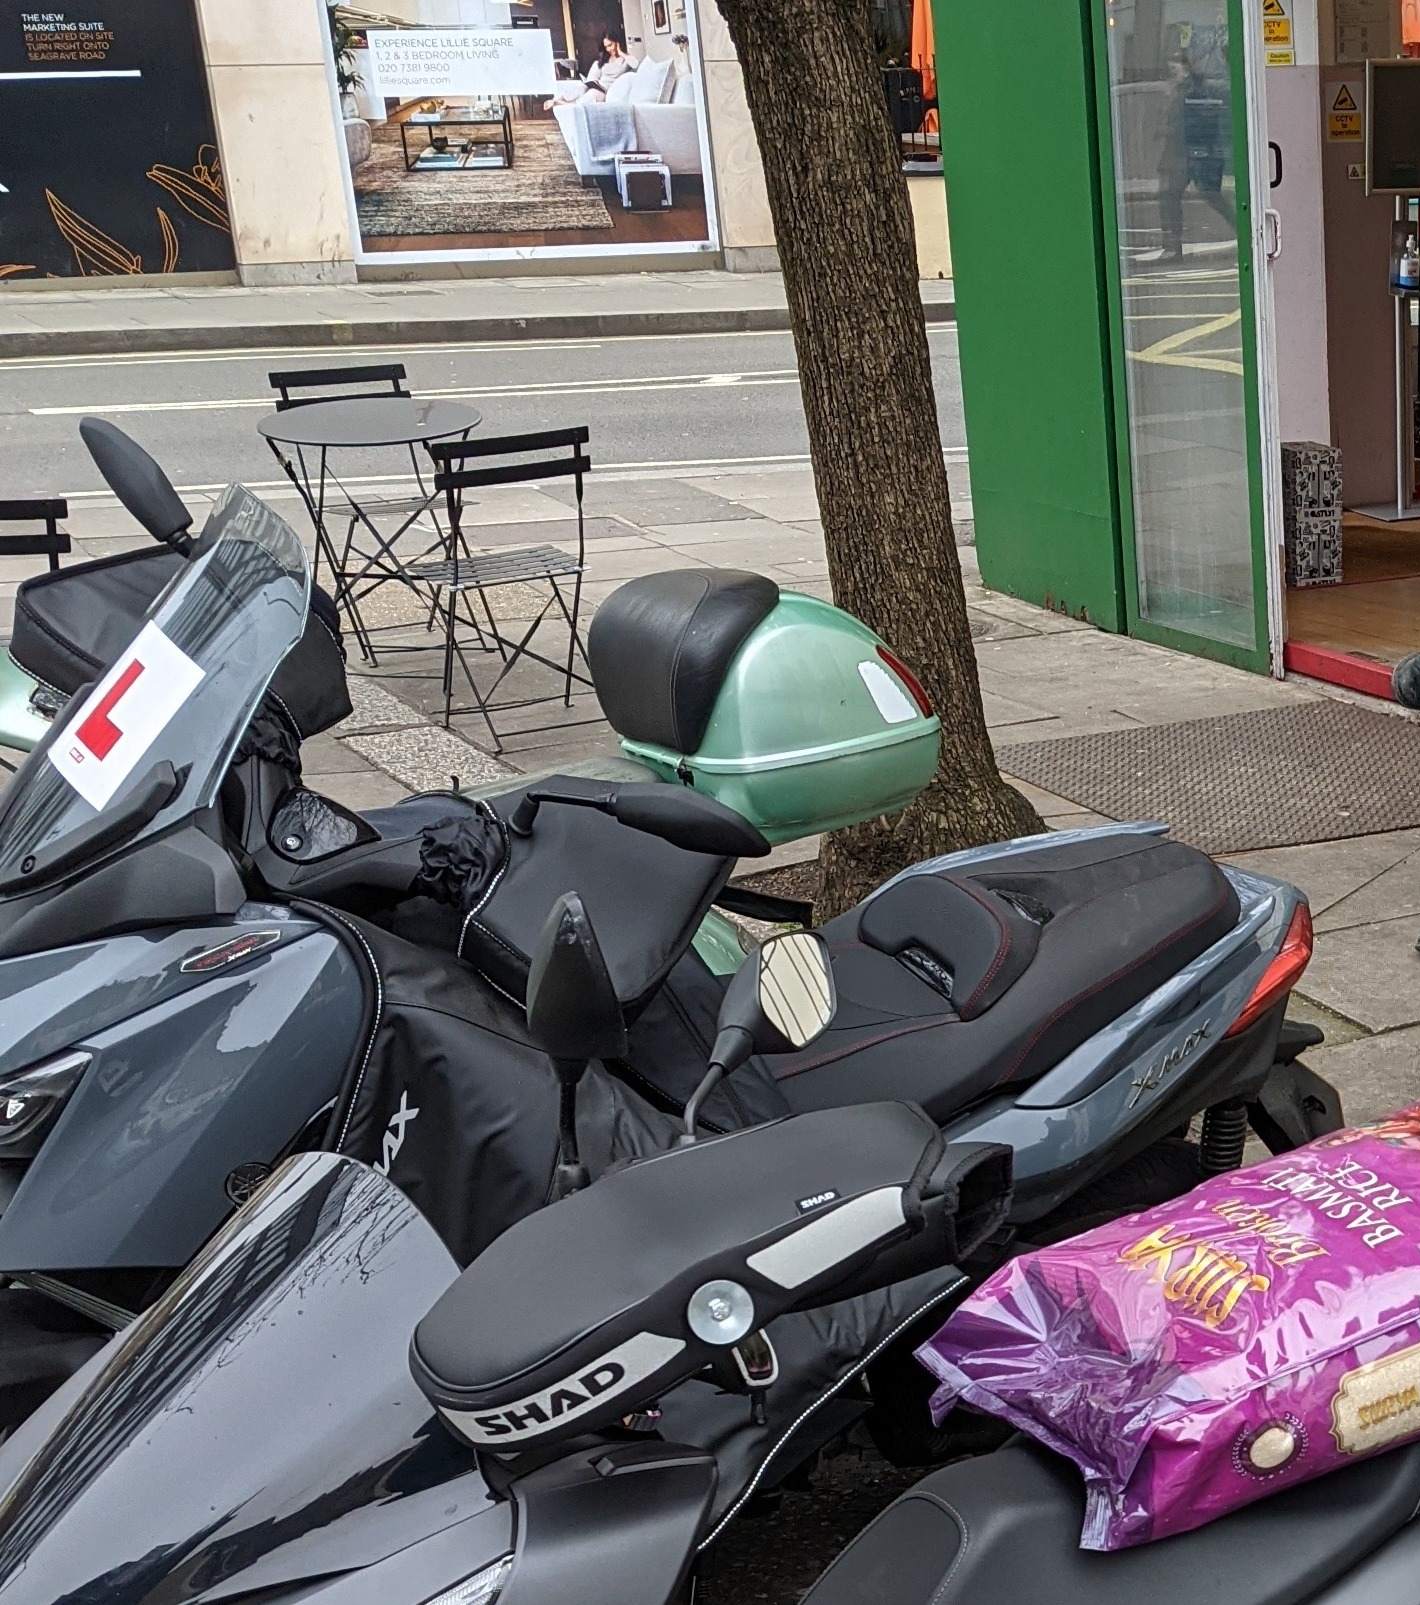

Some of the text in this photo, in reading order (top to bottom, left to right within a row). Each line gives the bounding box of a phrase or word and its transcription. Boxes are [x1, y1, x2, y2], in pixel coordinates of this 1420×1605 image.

[21, 13, 64, 22] THE NEW
[23, 22, 104, 32] MARKETING SUITE
[25, 31, 115, 41] IS LOCATED ON SITE
[26, 42, 110, 50] TURN RIGHT ONTO
[374, 38, 514, 48] EXPERIENCE LILLIE SQUARE
[28, 51, 106, 60] SEAGRAVE ROAD
[385, 51, 391, 60] 2
[393, 51, 401, 60] &
[402, 51, 409, 60] 3
[412, 50, 464, 60] BEDROOM
[466, 50, 500, 59] LIVING
[378, 63, 450, 72] 020 7381 9800
[1128, 1018, 1211, 1109] XMAX
[1324, 1157, 1414, 1212] RICE
[800, 1191, 836, 1208] SHAD
[1260, 1166, 1405, 1249] BASMATI
[1211, 1198, 1332, 1270] Broken
[474, 1361, 626, 1436] SHAD
